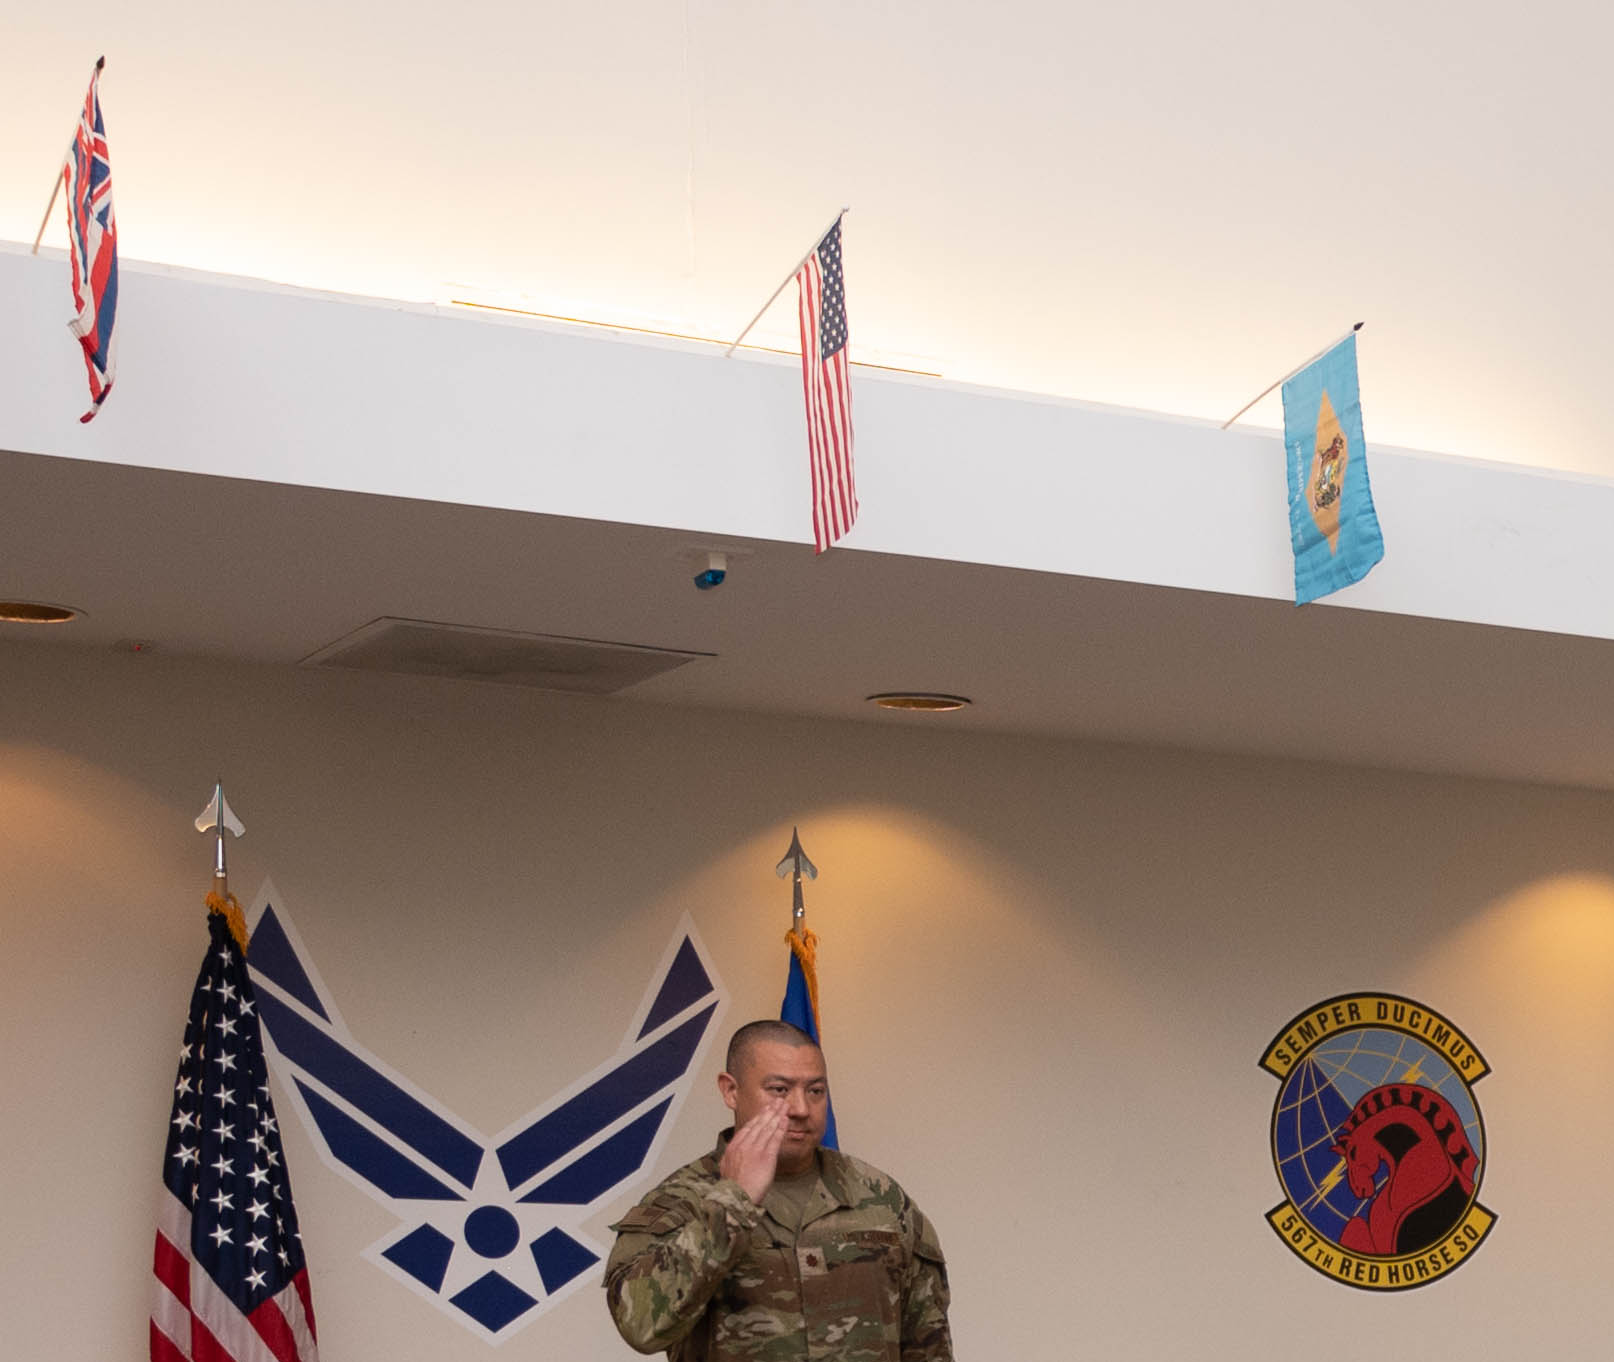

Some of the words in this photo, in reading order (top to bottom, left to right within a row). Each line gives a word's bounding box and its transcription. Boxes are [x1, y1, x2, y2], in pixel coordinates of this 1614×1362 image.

[1275, 1001, 1361, 1067] SEMPER
[1376, 1001, 1476, 1072] DUCIMUS
[1281, 1215, 1333, 1268] 567TH
[1339, 1258, 1380, 1284] RED
[1388, 1245, 1455, 1284] HORSE
[1454, 1225, 1479, 1253] SQ
